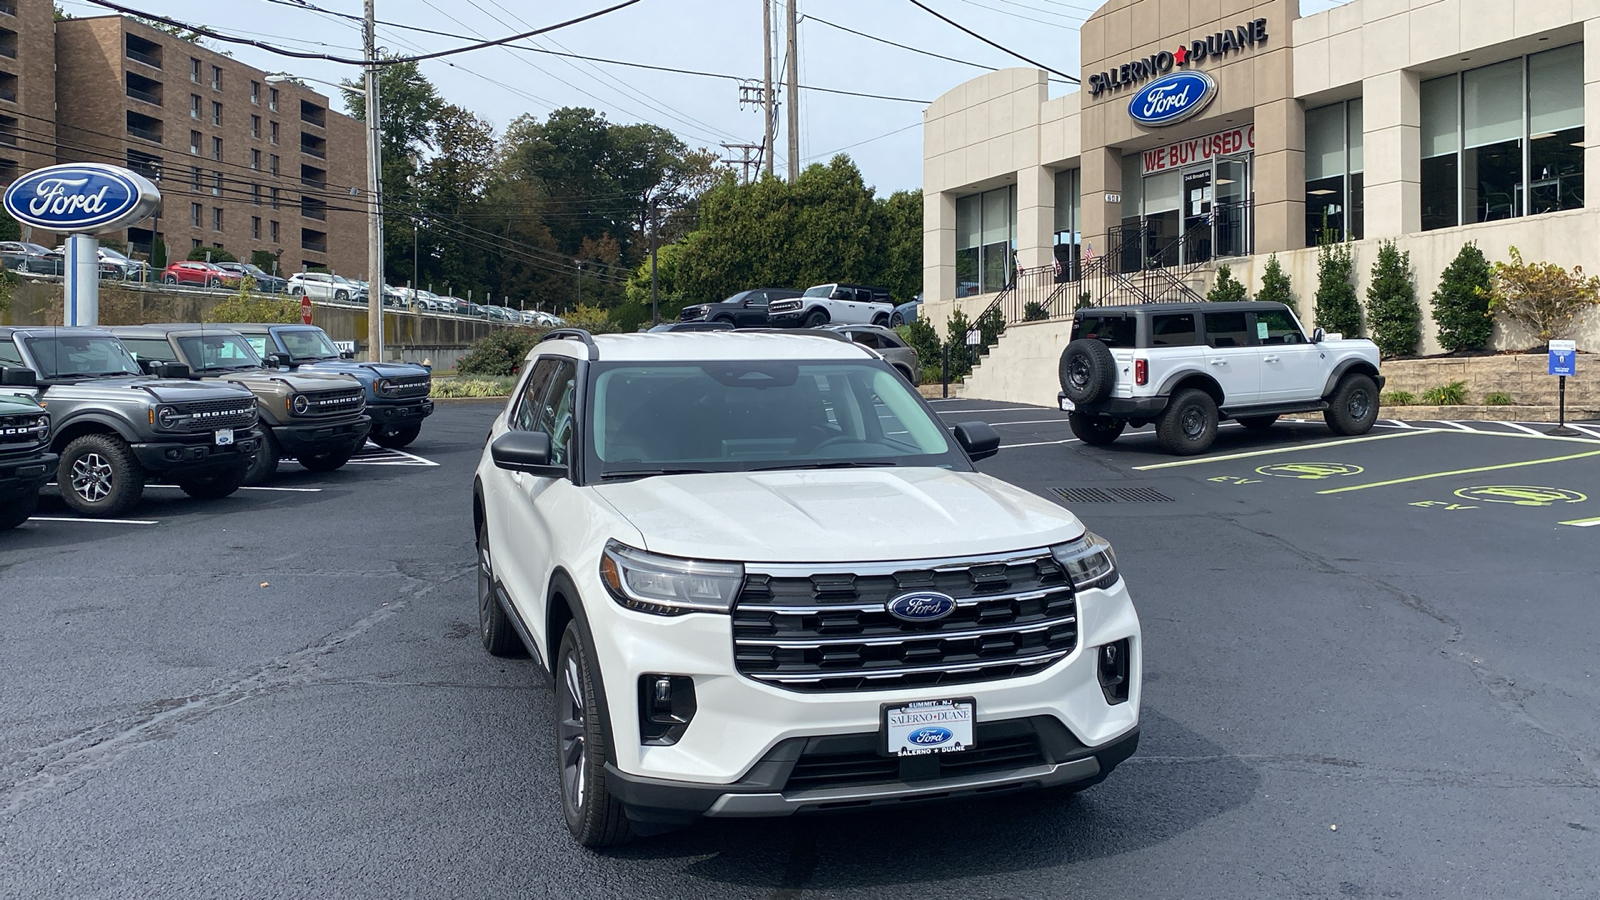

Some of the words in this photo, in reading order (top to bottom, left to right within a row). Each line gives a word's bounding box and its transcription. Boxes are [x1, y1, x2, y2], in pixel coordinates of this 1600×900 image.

[1088, 50, 1174, 94] SALERNO
[1191, 17, 1269, 62] DUANE
[1143, 82, 1190, 117] Ford
[1144, 148, 1165, 172] WE
[1169, 140, 1198, 166] BUY
[1202, 129, 1242, 159] USED
[29, 178, 109, 216] Ford
[302, 305, 311, 317] STOP
[320, 397, 357, 405] BRONCO
[192, 409, 244, 418] BRONCO
[905, 598, 942, 615] Ford
[890, 713, 933, 724] SALERNO
[937, 710, 970, 720] DUANE
[916, 729, 944, 743] Ford
[897, 748, 932, 757] SALERNO
[941, 745, 966, 753] DUANE
